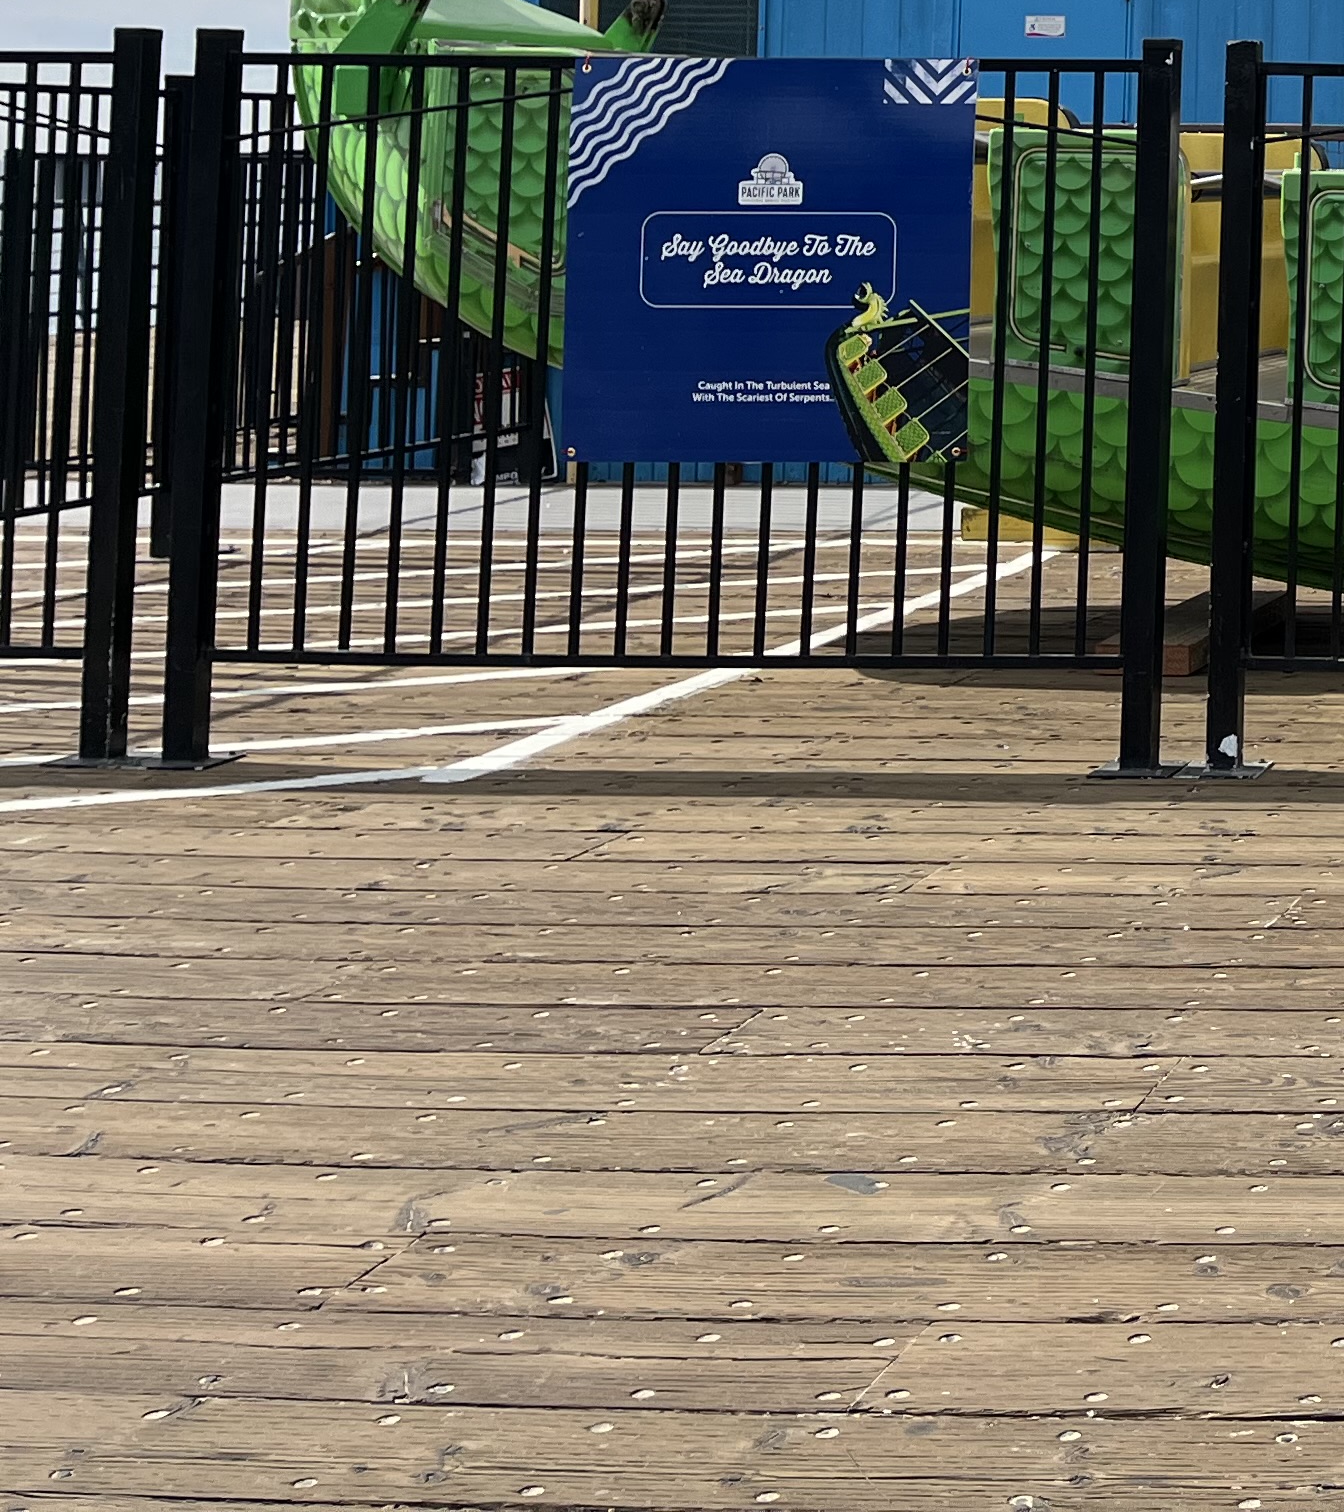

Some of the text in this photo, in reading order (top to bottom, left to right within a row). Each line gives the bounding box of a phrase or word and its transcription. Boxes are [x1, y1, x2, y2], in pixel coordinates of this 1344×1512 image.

[741, 187, 801, 198] PACIFIC PARK
[661, 233, 877, 262] Say Goodbye To The
[703, 261, 833, 291] Sea Dragon
[698, 381, 830, 392] Caught In The Turbulent Sea
[692, 393, 715, 402] With
[716, 393, 735, 402] The
[736, 393, 773, 402] Scariest
[774, 393, 788, 402] Of
